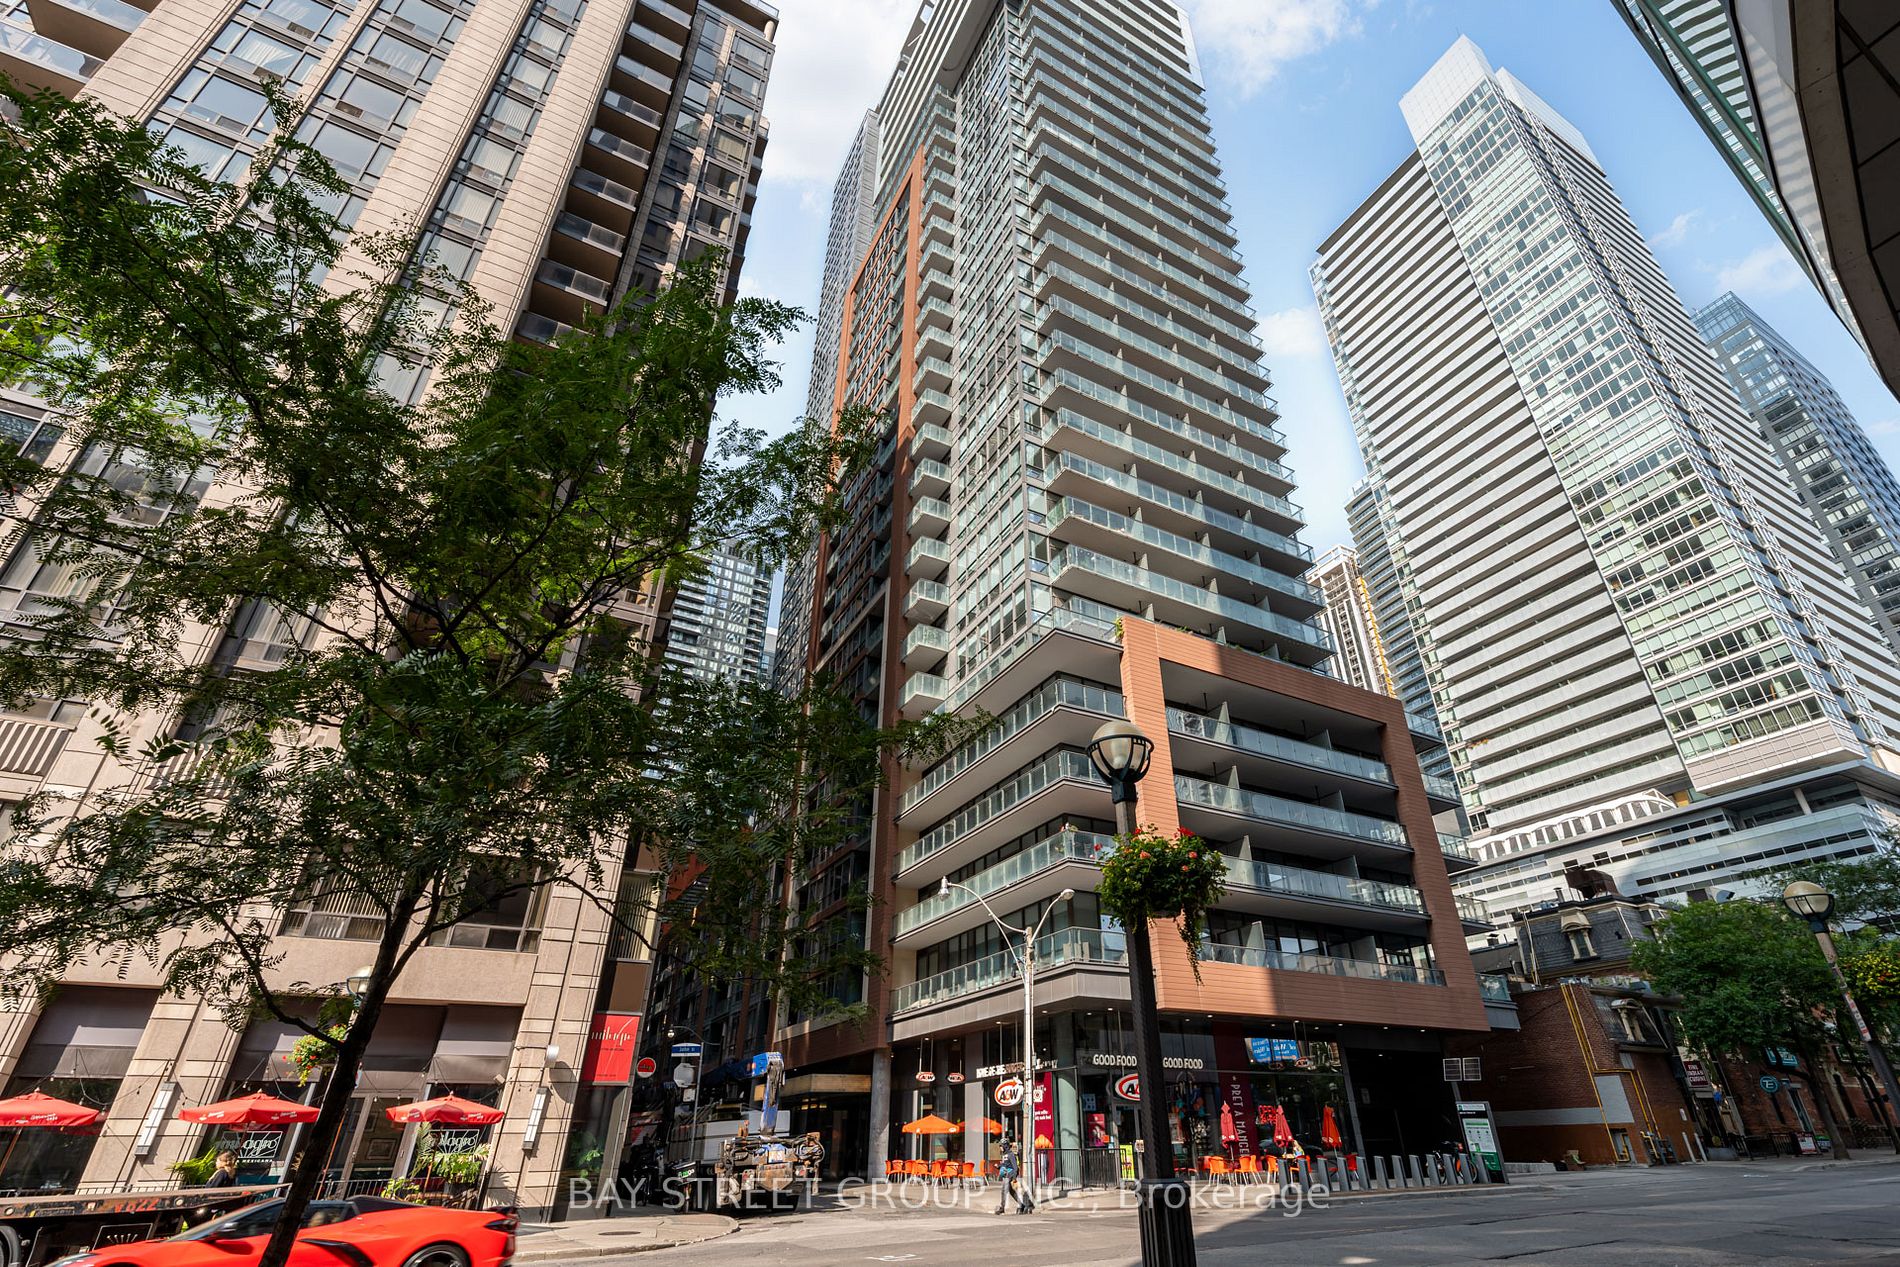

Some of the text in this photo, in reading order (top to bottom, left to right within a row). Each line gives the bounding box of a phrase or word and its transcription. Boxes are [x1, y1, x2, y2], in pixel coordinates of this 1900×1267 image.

[1093, 1054, 1138, 1067] GOOD FOOD
[1163, 1057, 1204, 1069] GOOD FOOD
[999, 1089, 1019, 1100] A&W
[1126, 1083, 1140, 1095] A&
[1231, 1084, 1244, 1107] PRET
